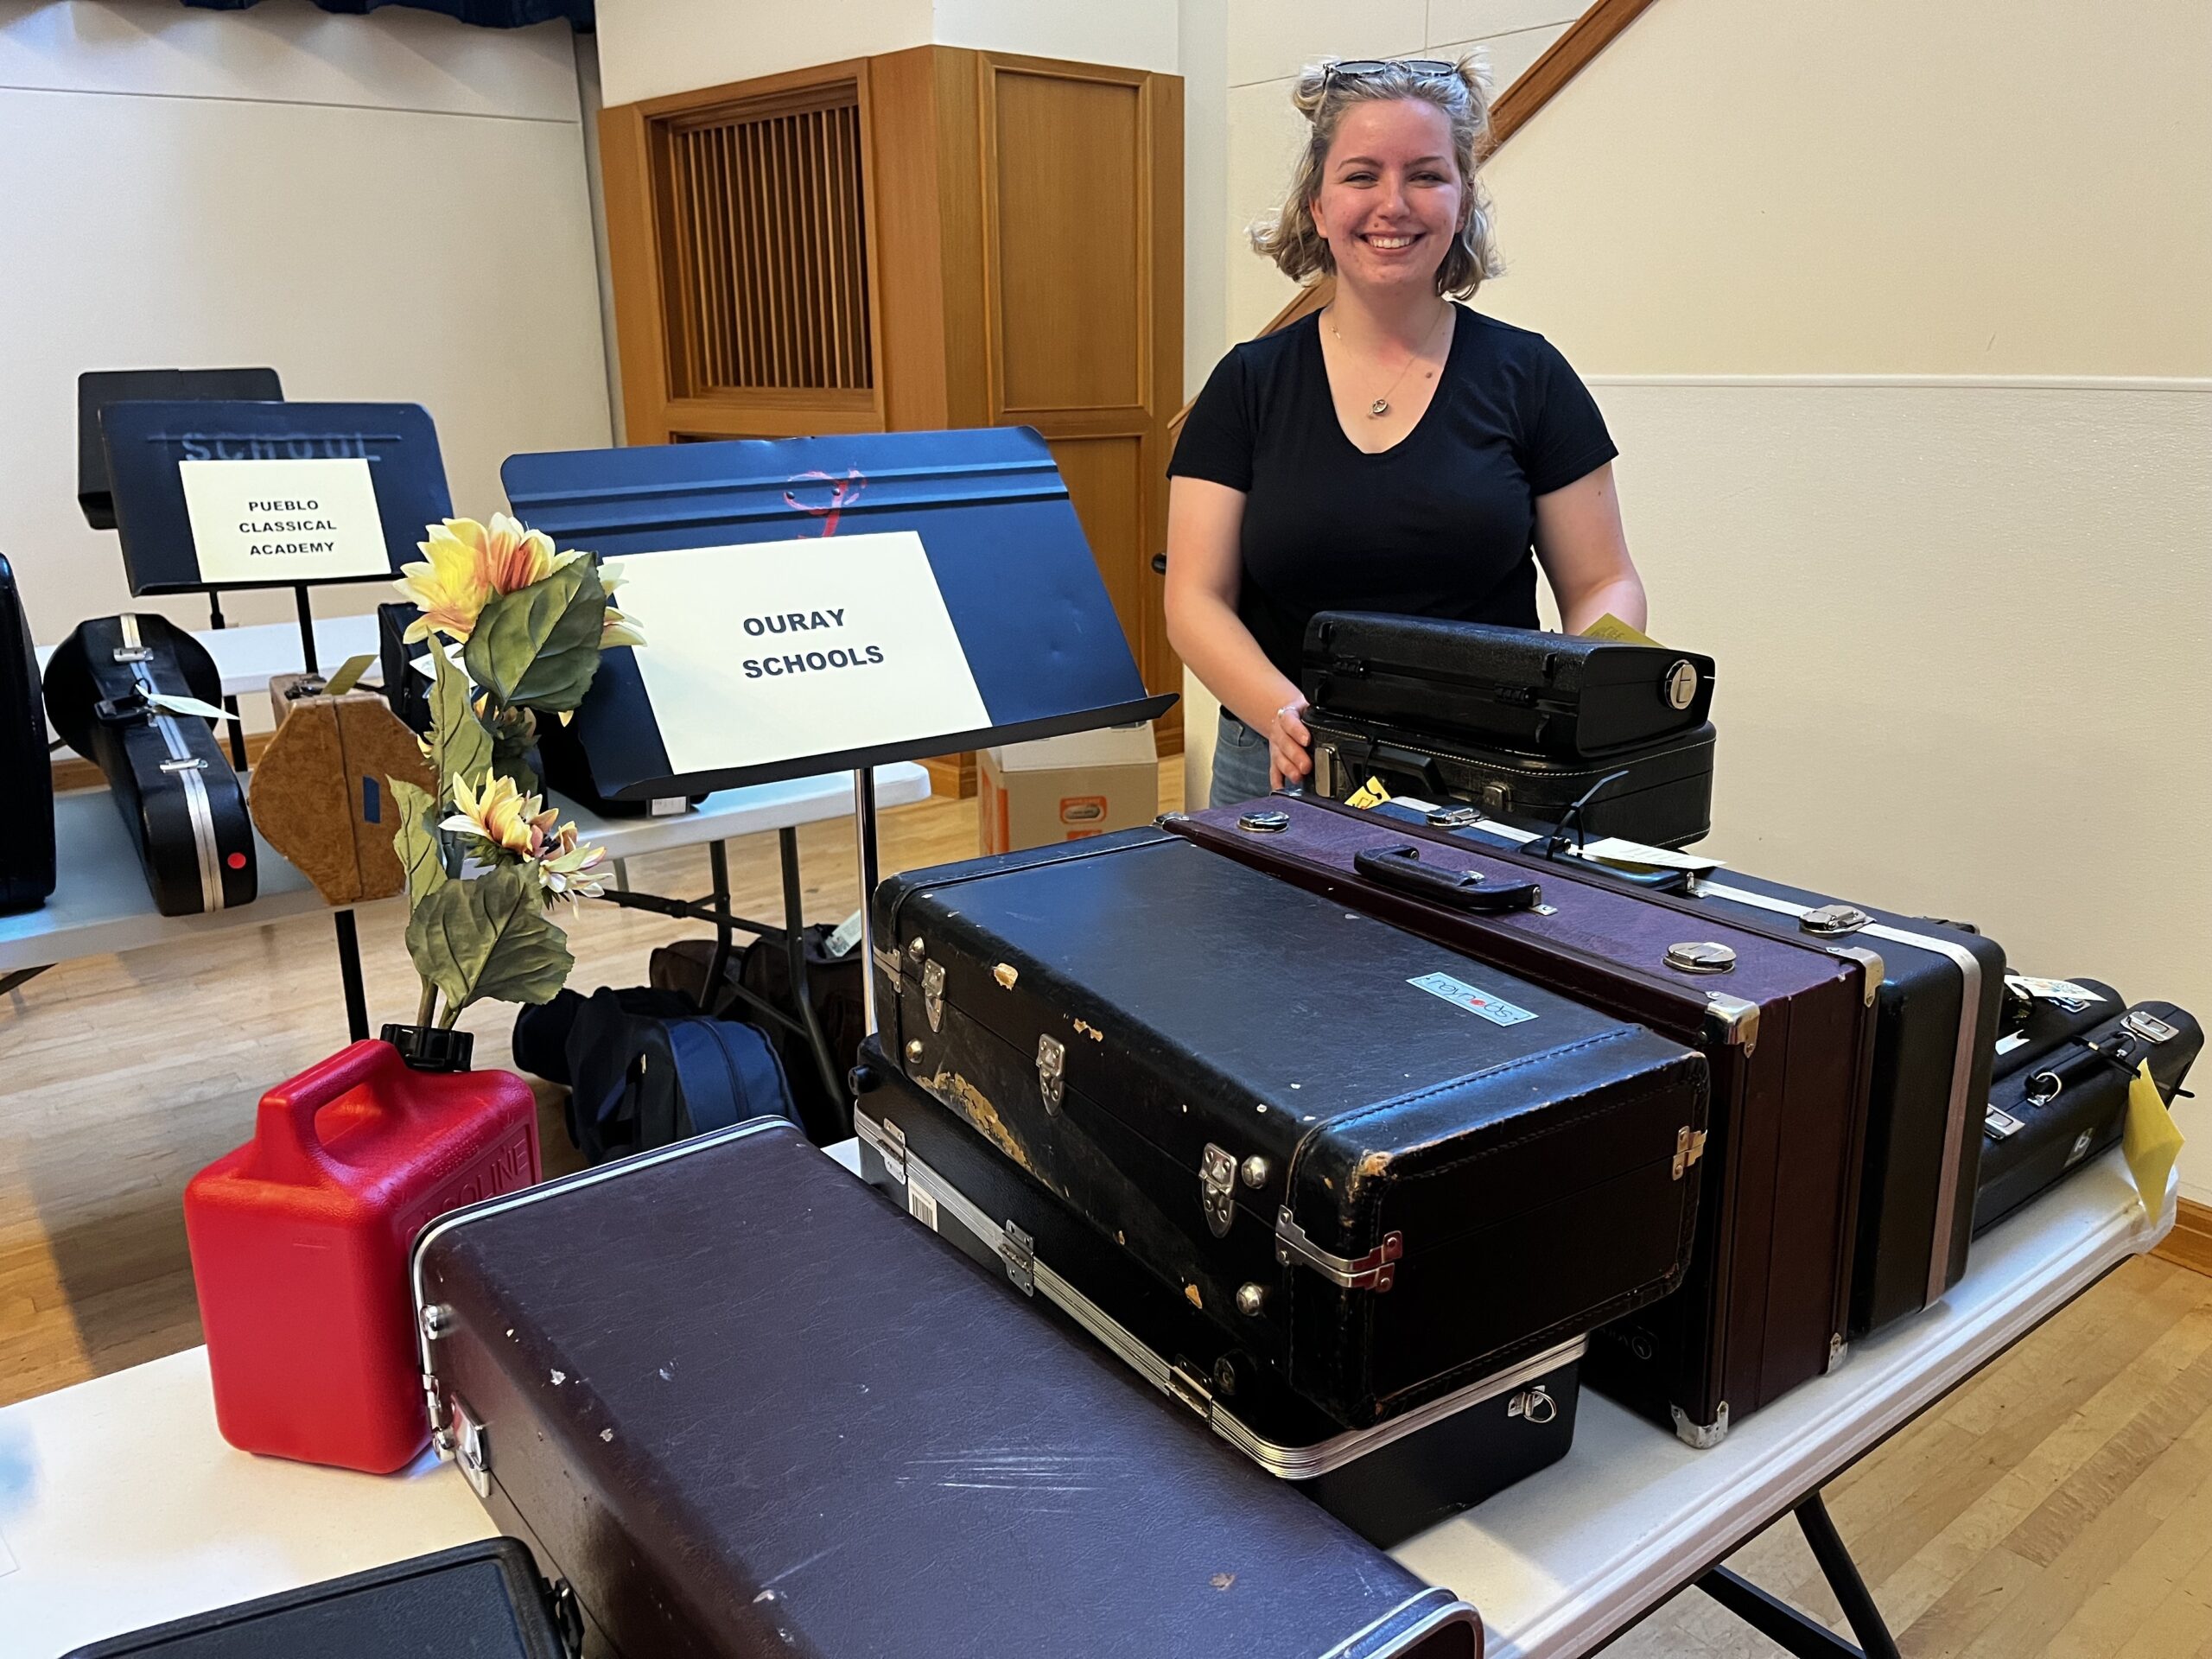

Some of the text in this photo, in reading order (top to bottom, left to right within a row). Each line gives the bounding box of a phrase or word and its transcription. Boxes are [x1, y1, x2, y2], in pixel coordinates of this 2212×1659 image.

[248, 499, 320, 512] PUEBLO
[238, 519, 338, 533] CLASSICAL
[249, 542, 335, 556] ACADEMY
[743, 608, 846, 637] OURAY
[742, 645, 884, 678] SCHOOLS
